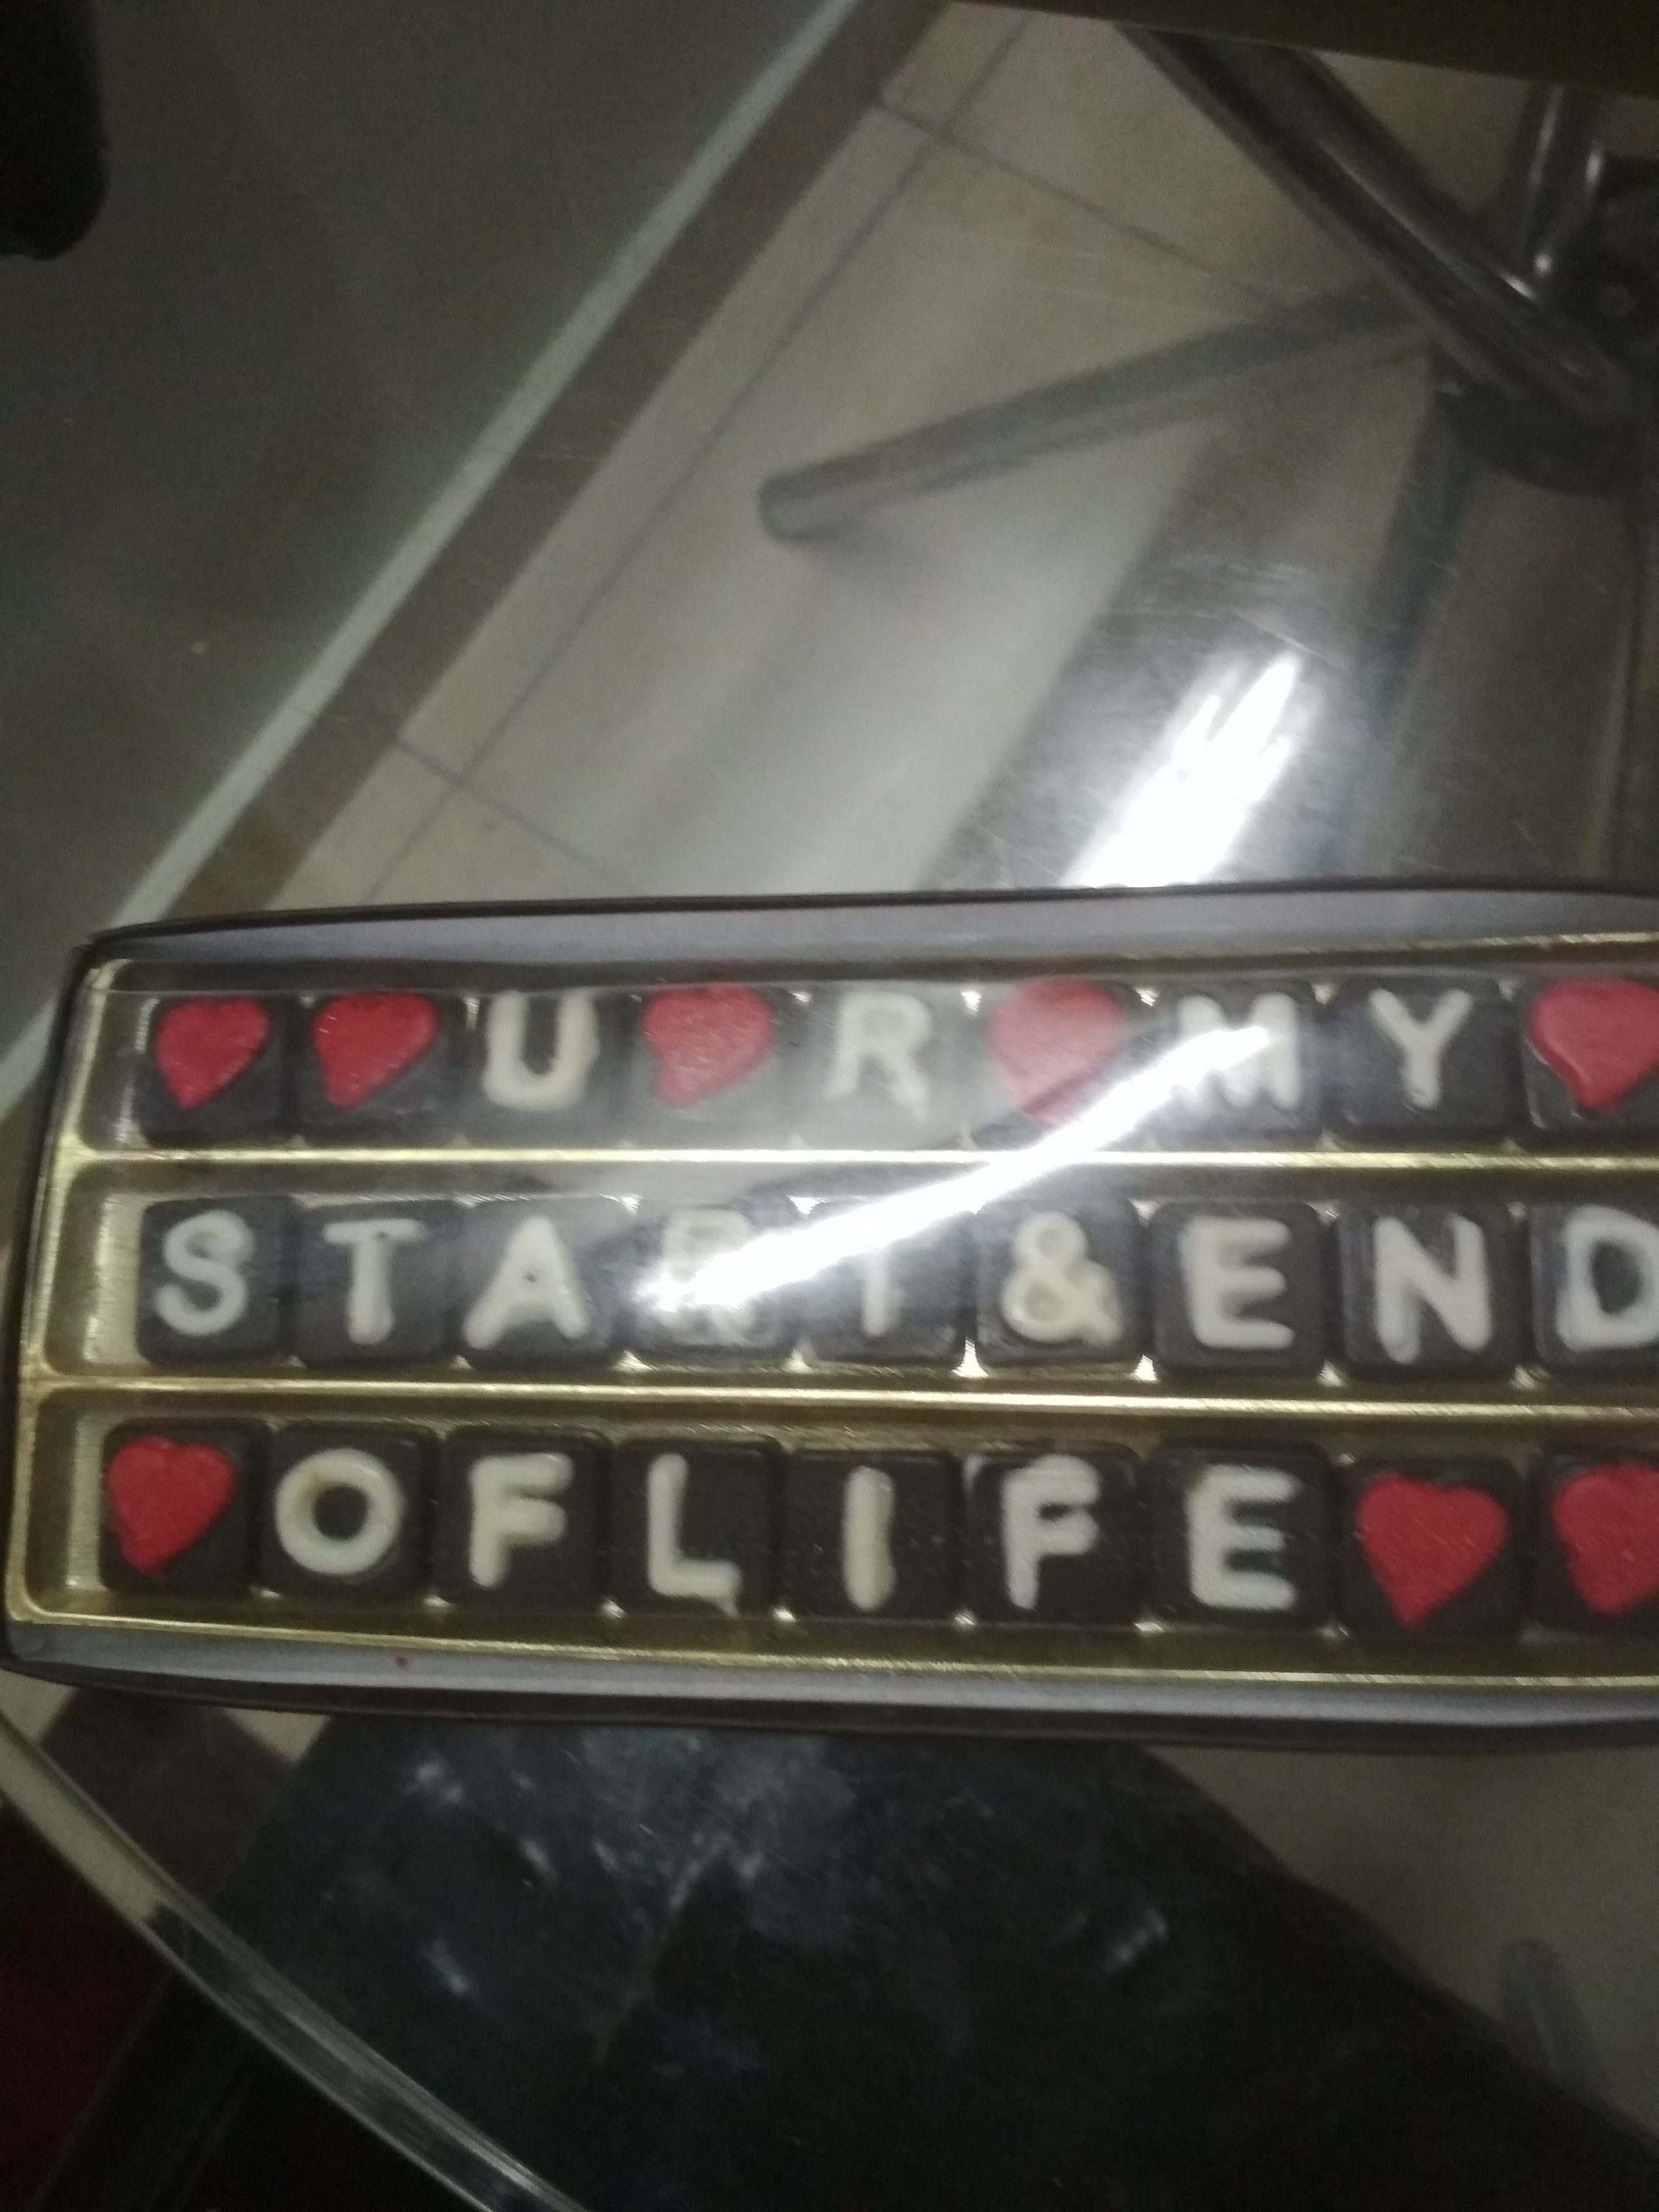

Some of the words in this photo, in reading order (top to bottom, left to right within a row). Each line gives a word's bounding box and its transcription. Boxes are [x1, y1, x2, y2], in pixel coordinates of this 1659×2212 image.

[483, 988, 600, 1110] U
[820, 988, 933, 1121] R
[1174, 990, 1473, 1110] MY
